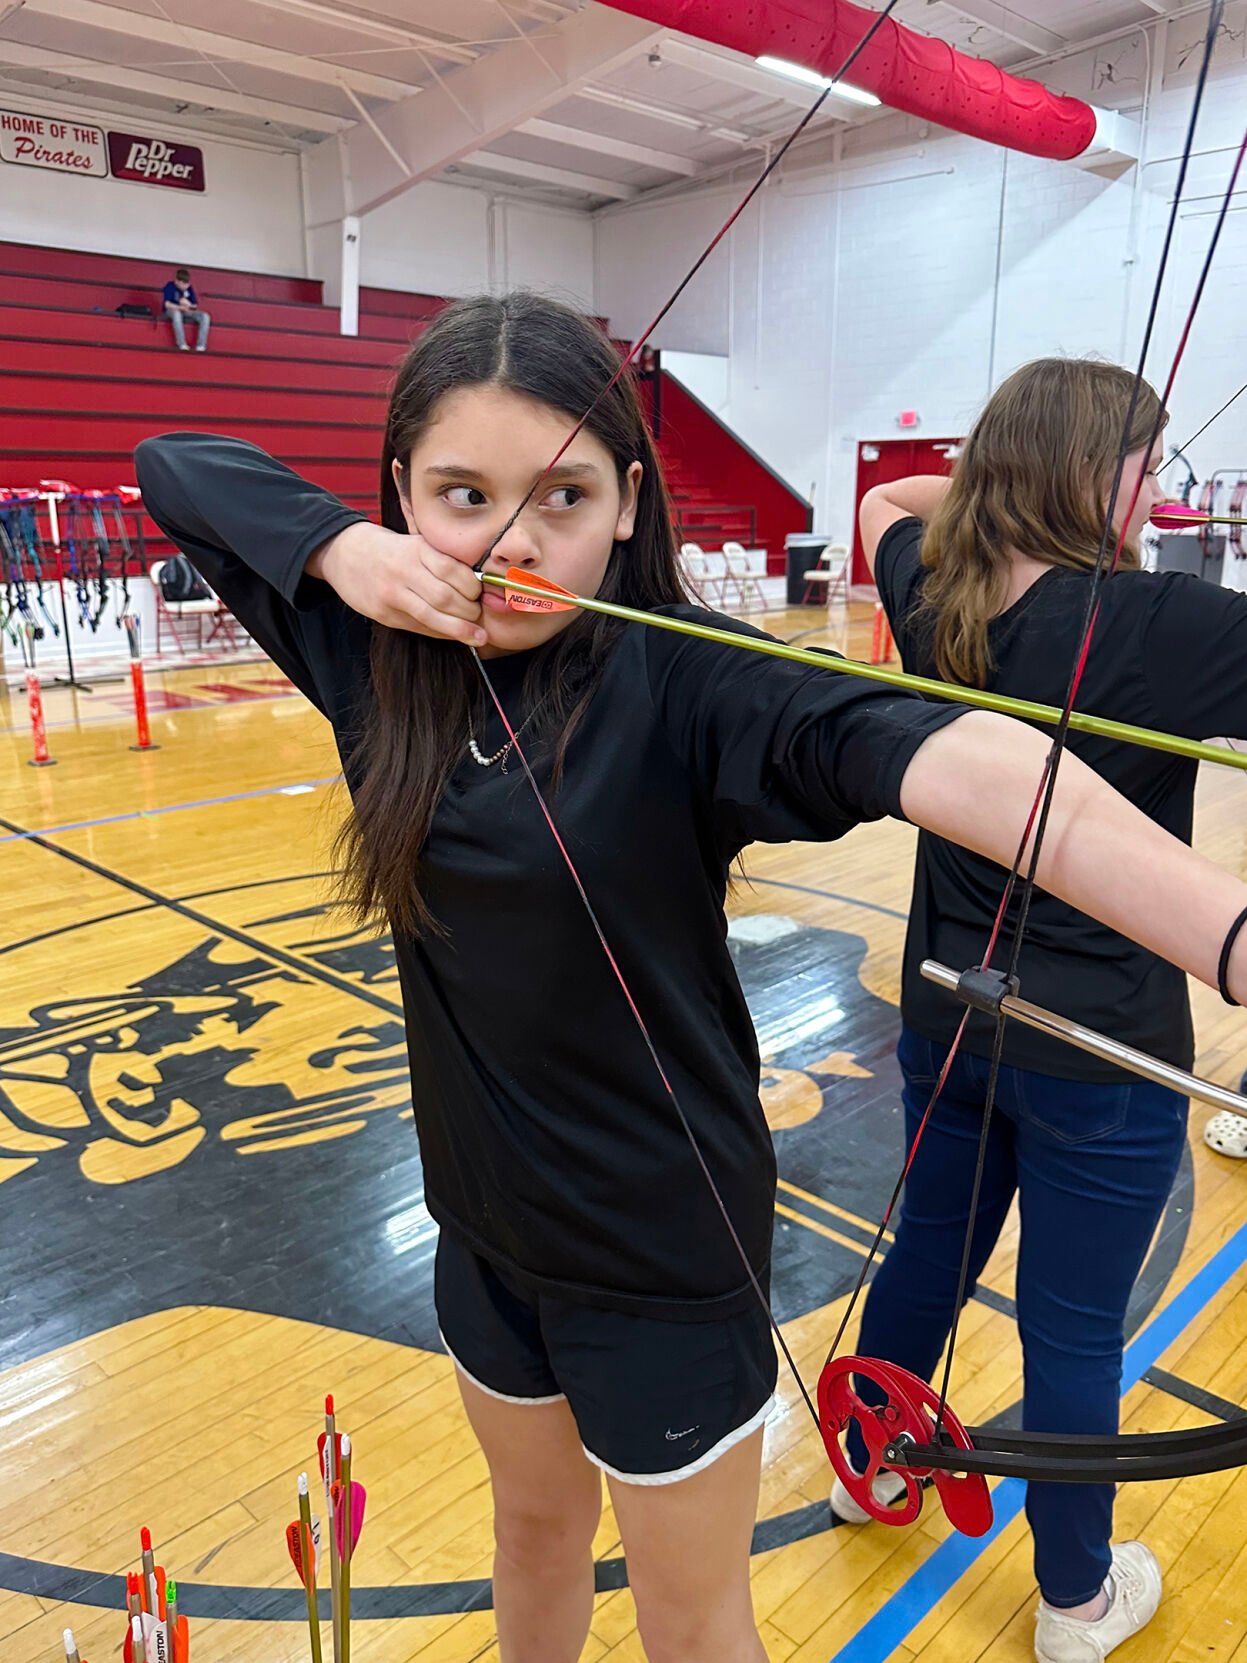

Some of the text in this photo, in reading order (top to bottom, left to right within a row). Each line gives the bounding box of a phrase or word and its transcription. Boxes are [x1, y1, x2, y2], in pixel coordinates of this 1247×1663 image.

[1, 114, 99, 145] HOME OF THE
[14, 136, 94, 170] Pirates
[125, 142, 194, 179] Pepper
[148, 140, 175, 161] Dr
[510, 594, 542, 607] EASTON
